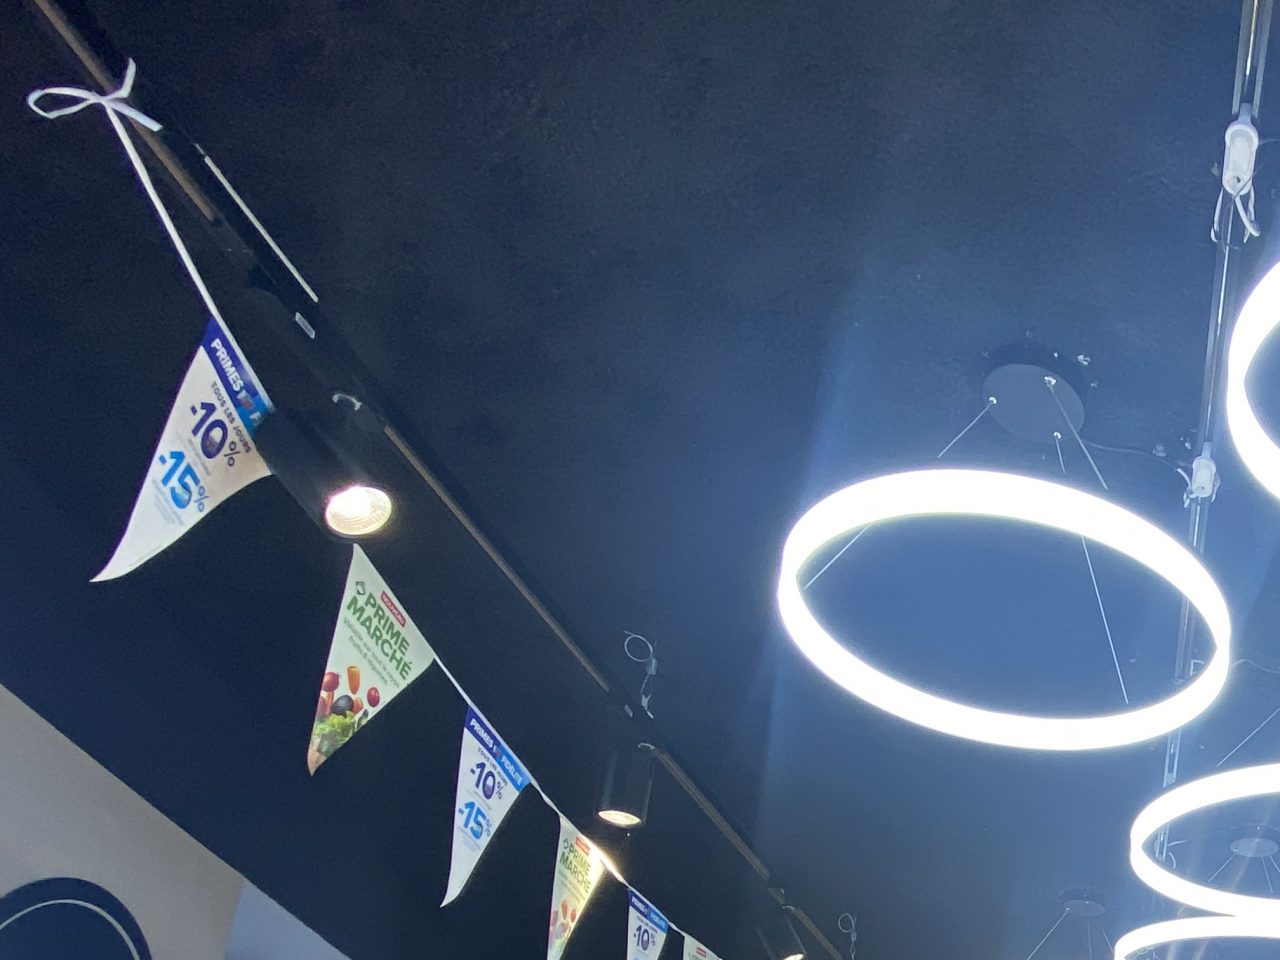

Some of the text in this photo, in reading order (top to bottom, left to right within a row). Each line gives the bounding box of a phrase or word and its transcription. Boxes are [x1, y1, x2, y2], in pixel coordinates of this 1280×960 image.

[211, 337, 244, 392] PRIMES
[347, 596, 414, 681] MARCHÉ
[365, 593, 410, 656] PRIME
